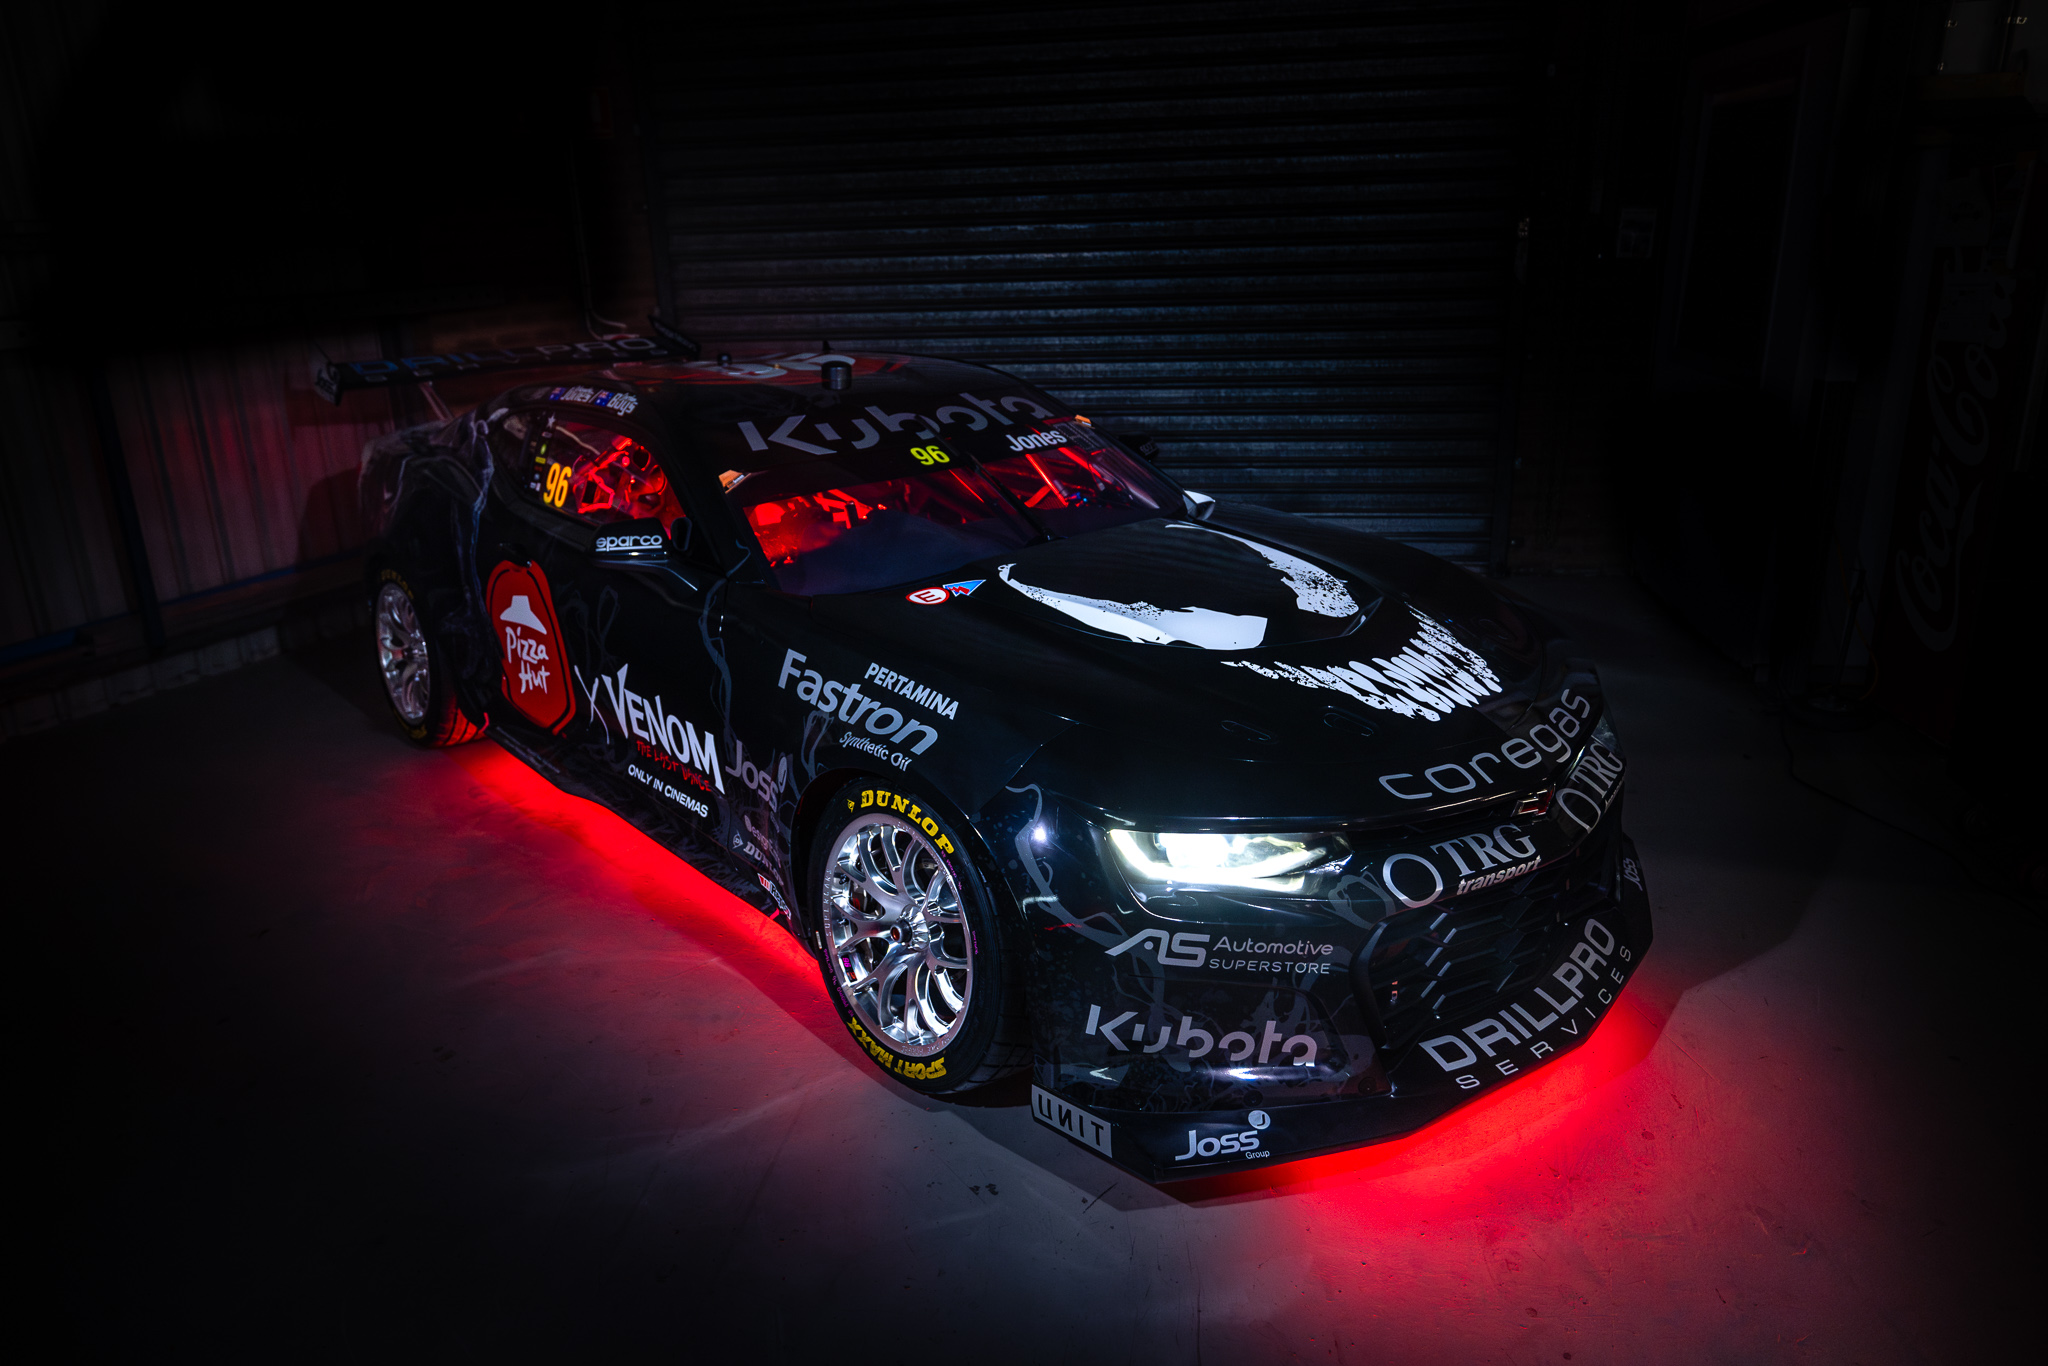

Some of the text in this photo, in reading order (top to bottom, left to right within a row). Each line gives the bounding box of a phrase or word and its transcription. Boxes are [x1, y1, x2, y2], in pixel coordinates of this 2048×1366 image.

[737, 392, 1054, 456] Kubota
[1005, 428, 1067, 452] Jones
[909, 445, 950, 466] 96
[543, 462, 572, 508] 96
[595, 533, 663, 551] sparco
[505, 626, 549, 664] Pizza
[518, 660, 551, 695] Hut
[864, 662, 960, 721] PERTAMINA
[777, 648, 939, 757] Fastron
[602, 662, 726, 796] VENOM
[839, 730, 913, 773] Synthetic Oil
[1378, 688, 1591, 800] coregas
[628, 764, 709, 818] ONLY IN CINEMAS
[724, 740, 779, 813] Joss
[861, 789, 955, 855] DUNLOP
[1456, 854, 1542, 896] transport
[1209, 958, 1331, 975] SUPERSTORE
[1213, 936, 1334, 956] Automotive
[1418, 918, 1615, 1073] DRILLPRO
[1455, 945, 1632, 1090] SERVICES
[846, 1016, 894, 1069] MAXX
[1085, 1004, 1318, 1067] Kubota
[894, 1056, 947, 1080] SPORT
[1037, 1094, 1105, 1148] UNIT
[1175, 1130, 1260, 1161] Joss
[1245, 1150, 1270, 1160] Group
